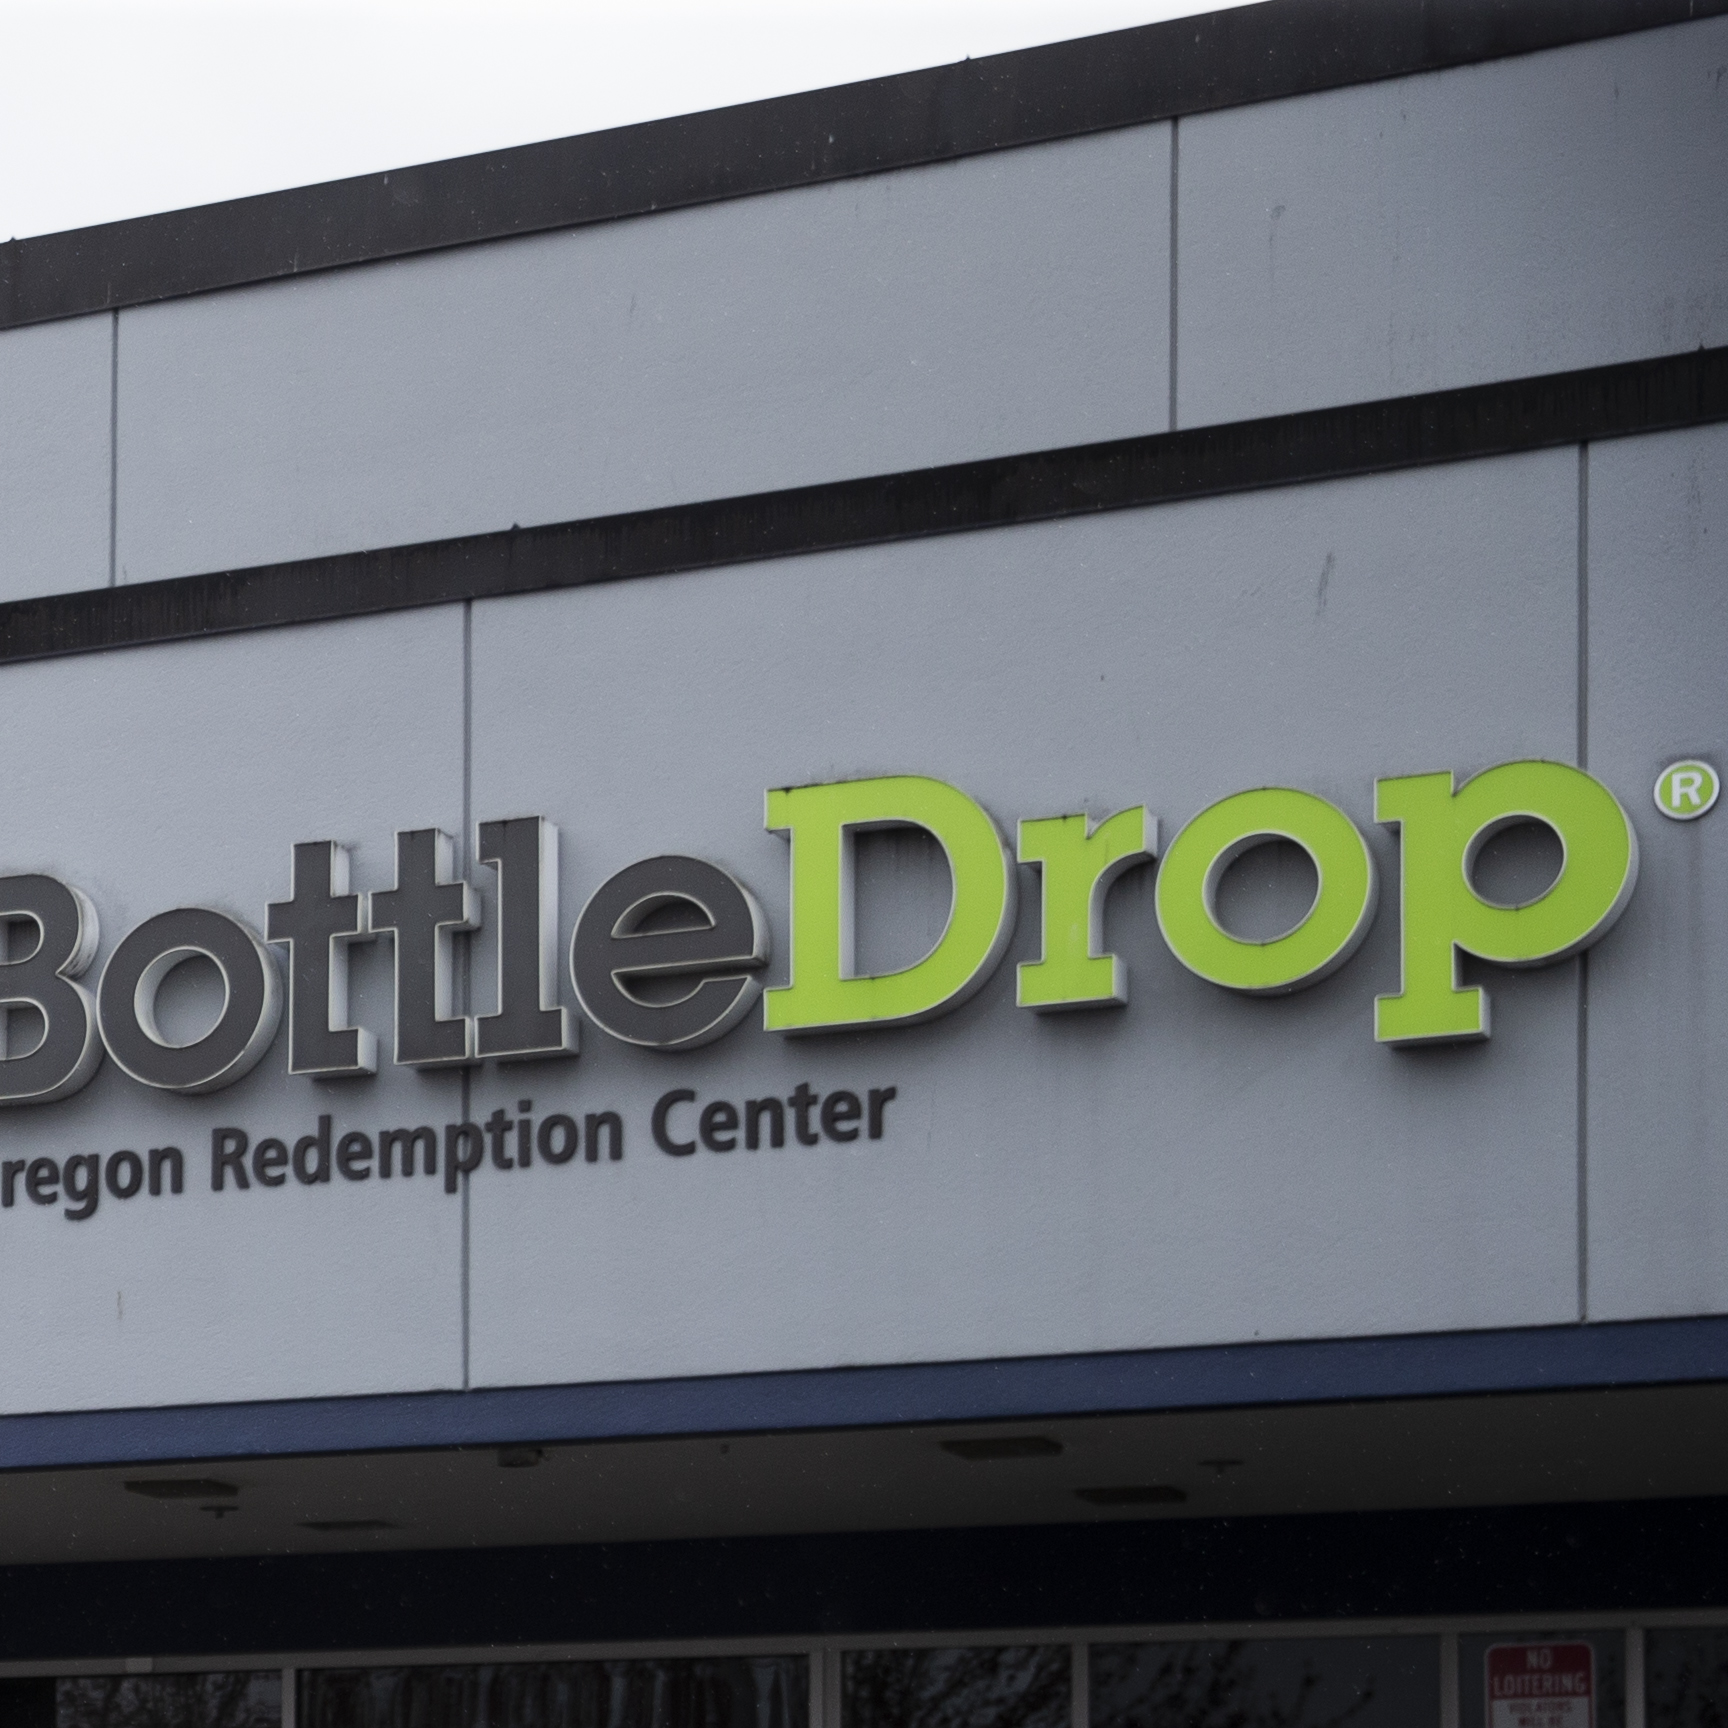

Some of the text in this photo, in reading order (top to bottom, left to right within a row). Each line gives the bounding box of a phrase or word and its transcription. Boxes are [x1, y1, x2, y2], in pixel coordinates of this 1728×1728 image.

[209, 1098, 627, 1194] Redemption
[650, 1078, 898, 1158] Center
[1525, 1647, 1554, 1670] NO
[1492, 1672, 1586, 1698] LOITERING
